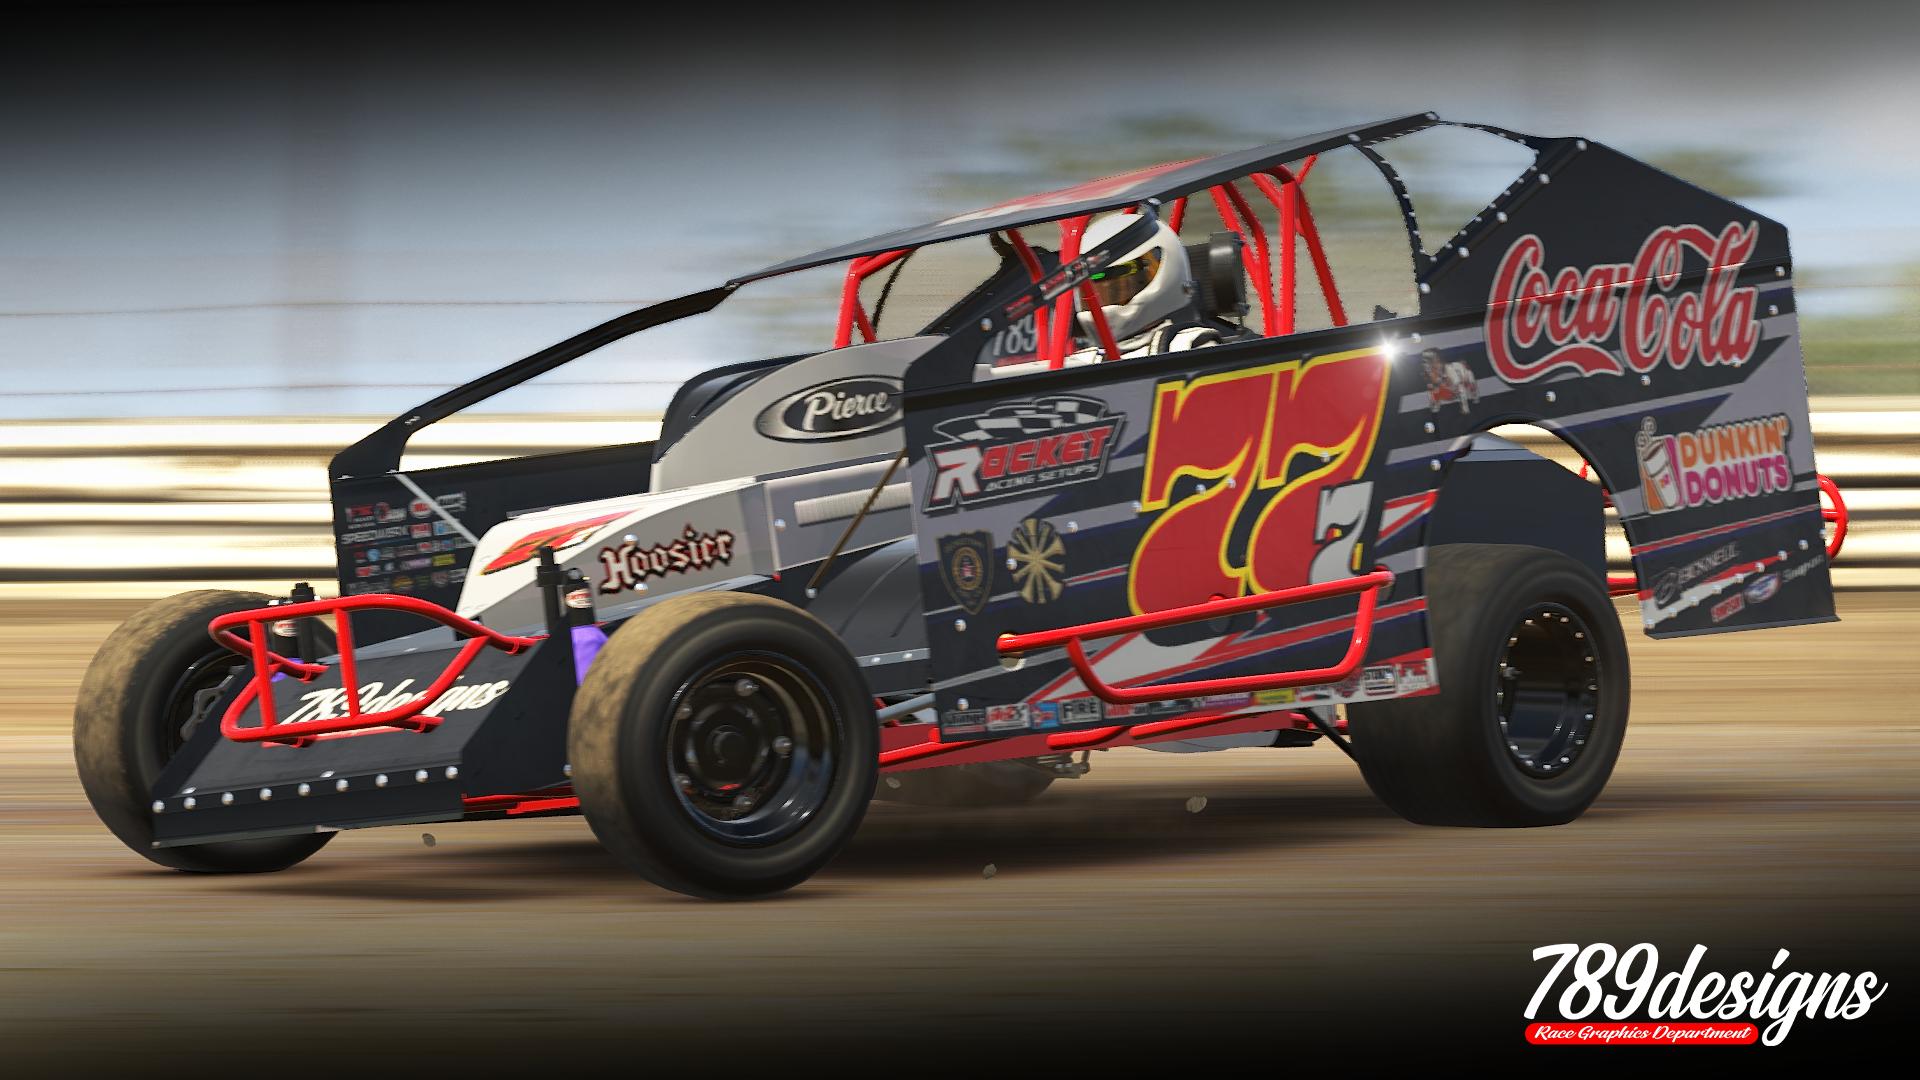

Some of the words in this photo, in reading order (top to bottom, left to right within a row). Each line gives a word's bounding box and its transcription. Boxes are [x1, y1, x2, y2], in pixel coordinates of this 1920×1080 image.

[801, 391, 892, 431] Pierce
[930, 425, 1115, 503] ROCKET
[1036, 462, 1099, 482] SETUPS
[1127, 345, 1392, 617] 77
[1684, 454, 1792, 508] DONUTS
[598, 524, 736, 596] Hoosier
[1309, 481, 1375, 584] 7
[279, 674, 511, 725] 789desgns
